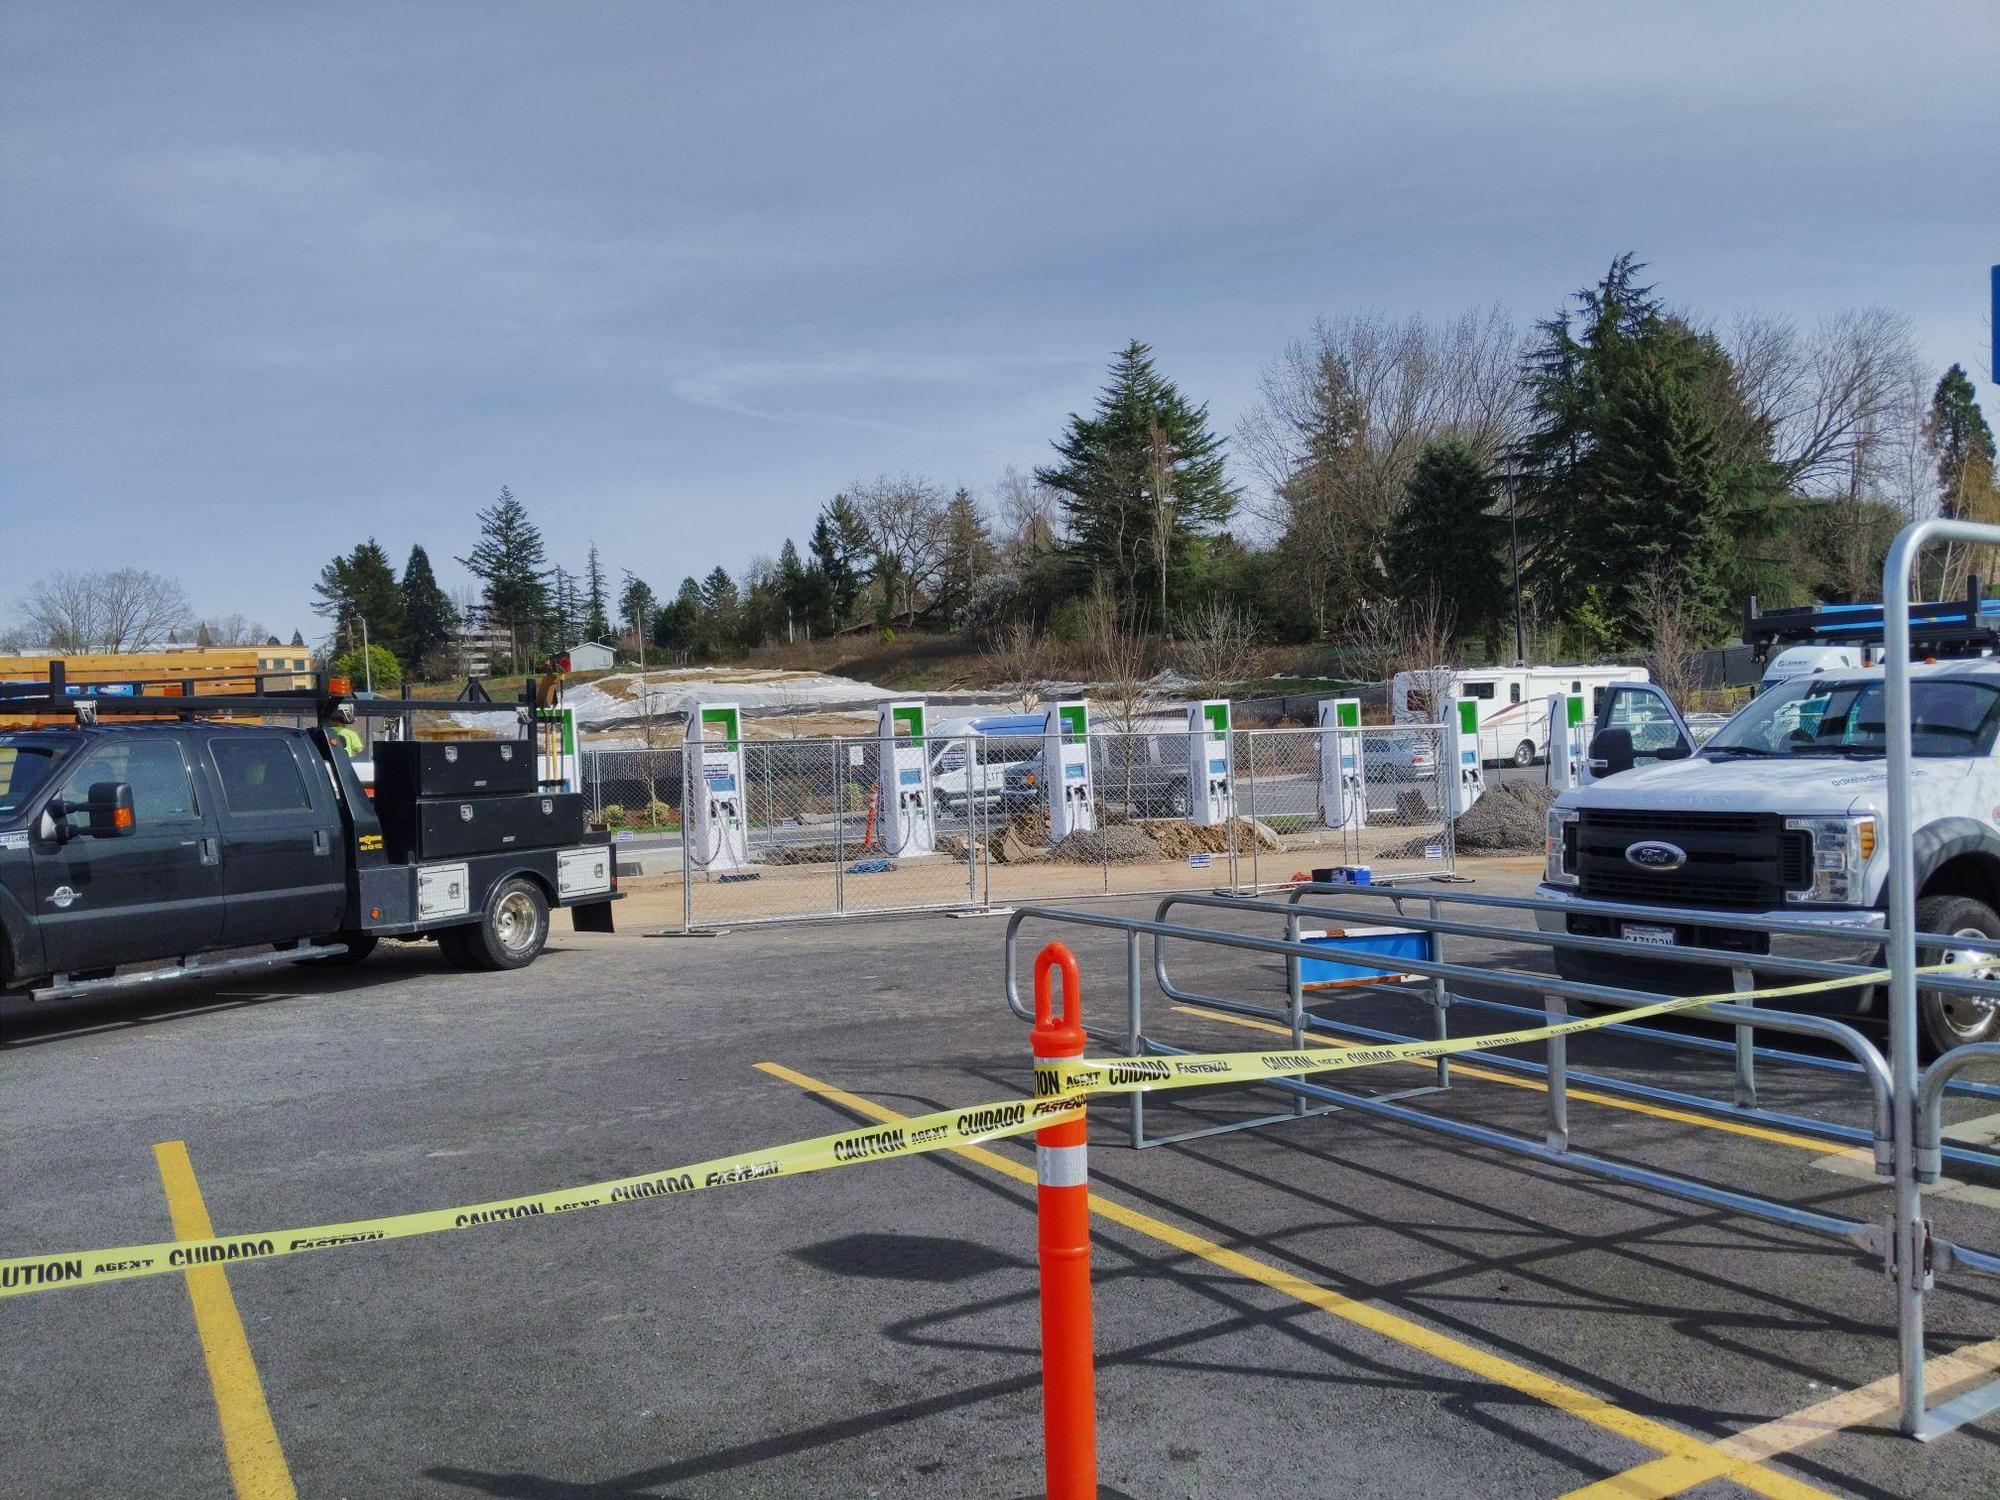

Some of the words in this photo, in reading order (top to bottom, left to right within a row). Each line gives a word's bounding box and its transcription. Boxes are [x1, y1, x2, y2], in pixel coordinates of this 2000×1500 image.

[1640, 848, 1668, 863] Ford
[1108, 1059, 1171, 1086] CUIDADO
[1175, 1061, 1232, 1075] FASTENAL
[1261, 1055, 1317, 1071] CAUTION
[94, 1259, 154, 1274] AGENT
[169, 1239, 275, 1266] CUIDADO
[455, 1202, 545, 1227] CAUTION
[610, 1174, 696, 1202] CUIDADO
[834, 1128, 908, 1162] CAUTION
[911, 1125, 949, 1143] AGENT
[956, 1103, 1026, 1136] CUIDADO
[1033, 1092, 1088, 1117] FASTENA
